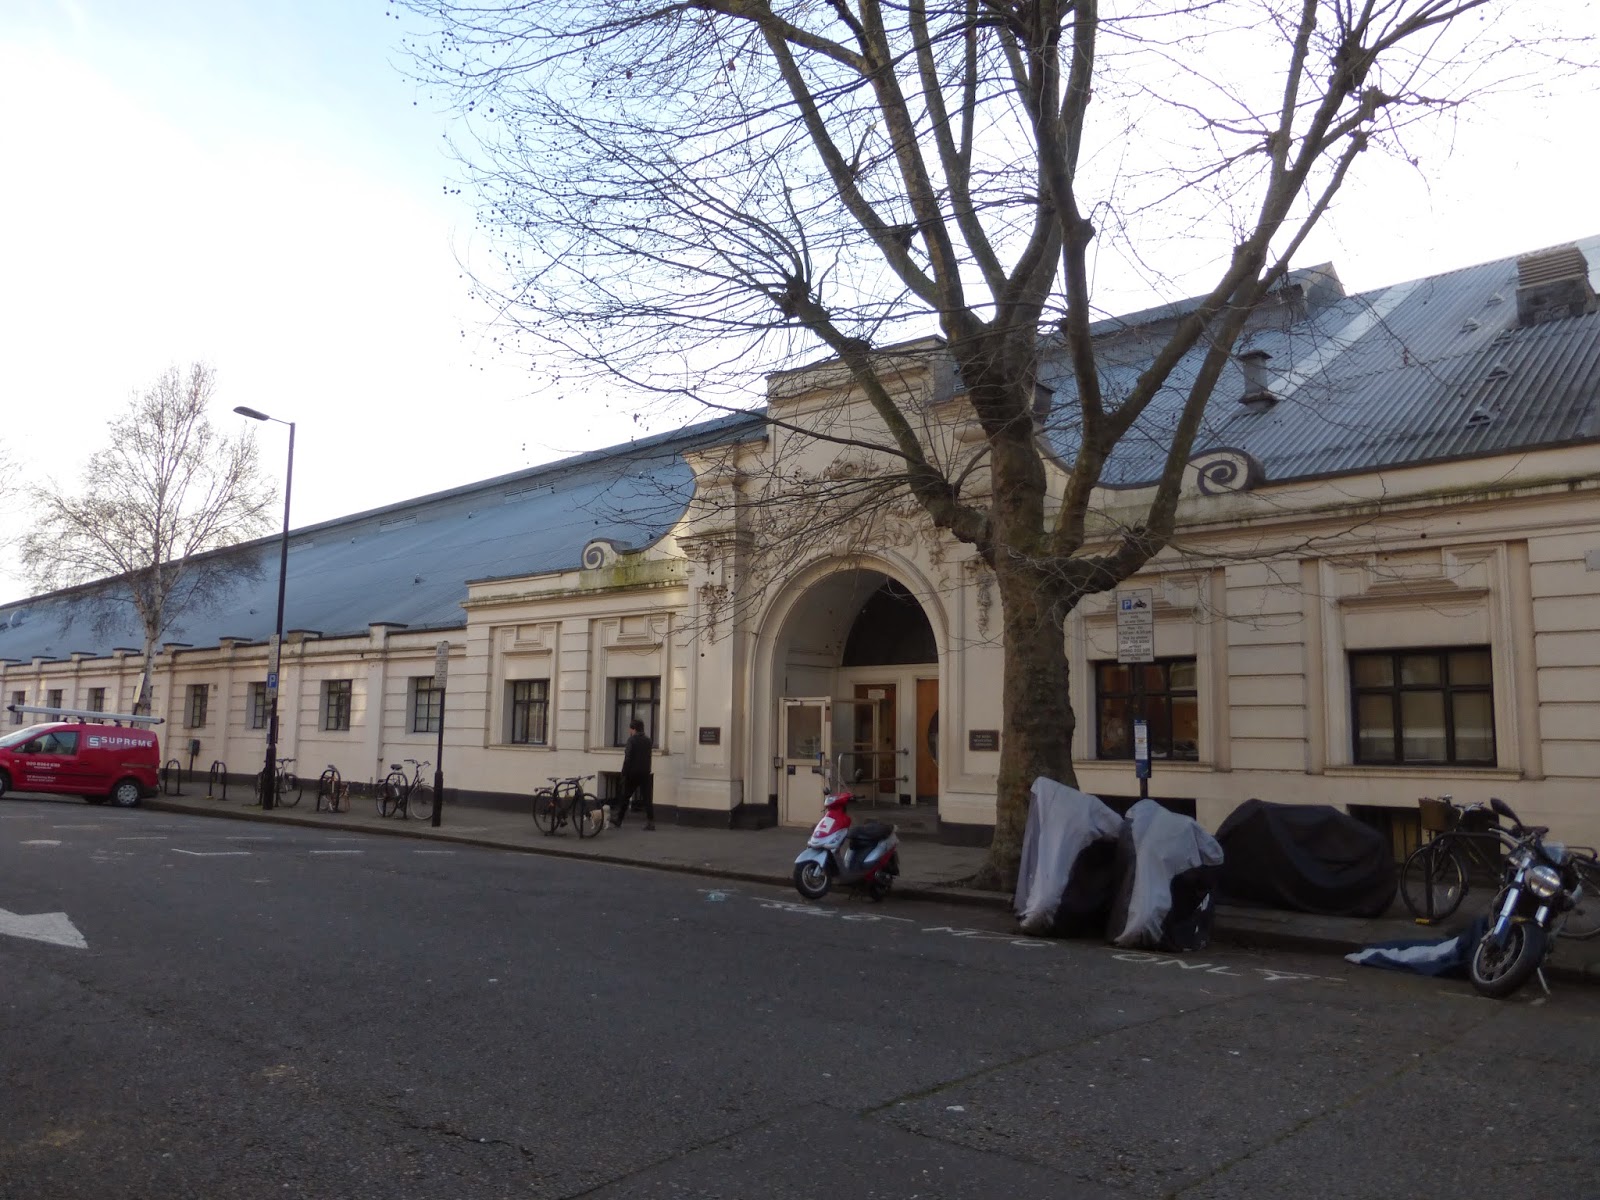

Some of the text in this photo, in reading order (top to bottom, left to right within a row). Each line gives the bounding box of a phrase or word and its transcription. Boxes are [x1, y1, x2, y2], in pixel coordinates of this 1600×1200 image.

[269, 675, 276, 686] P
[101, 736, 153, 748] SUPREME
[1111, 953, 1312, 981] ONLY
